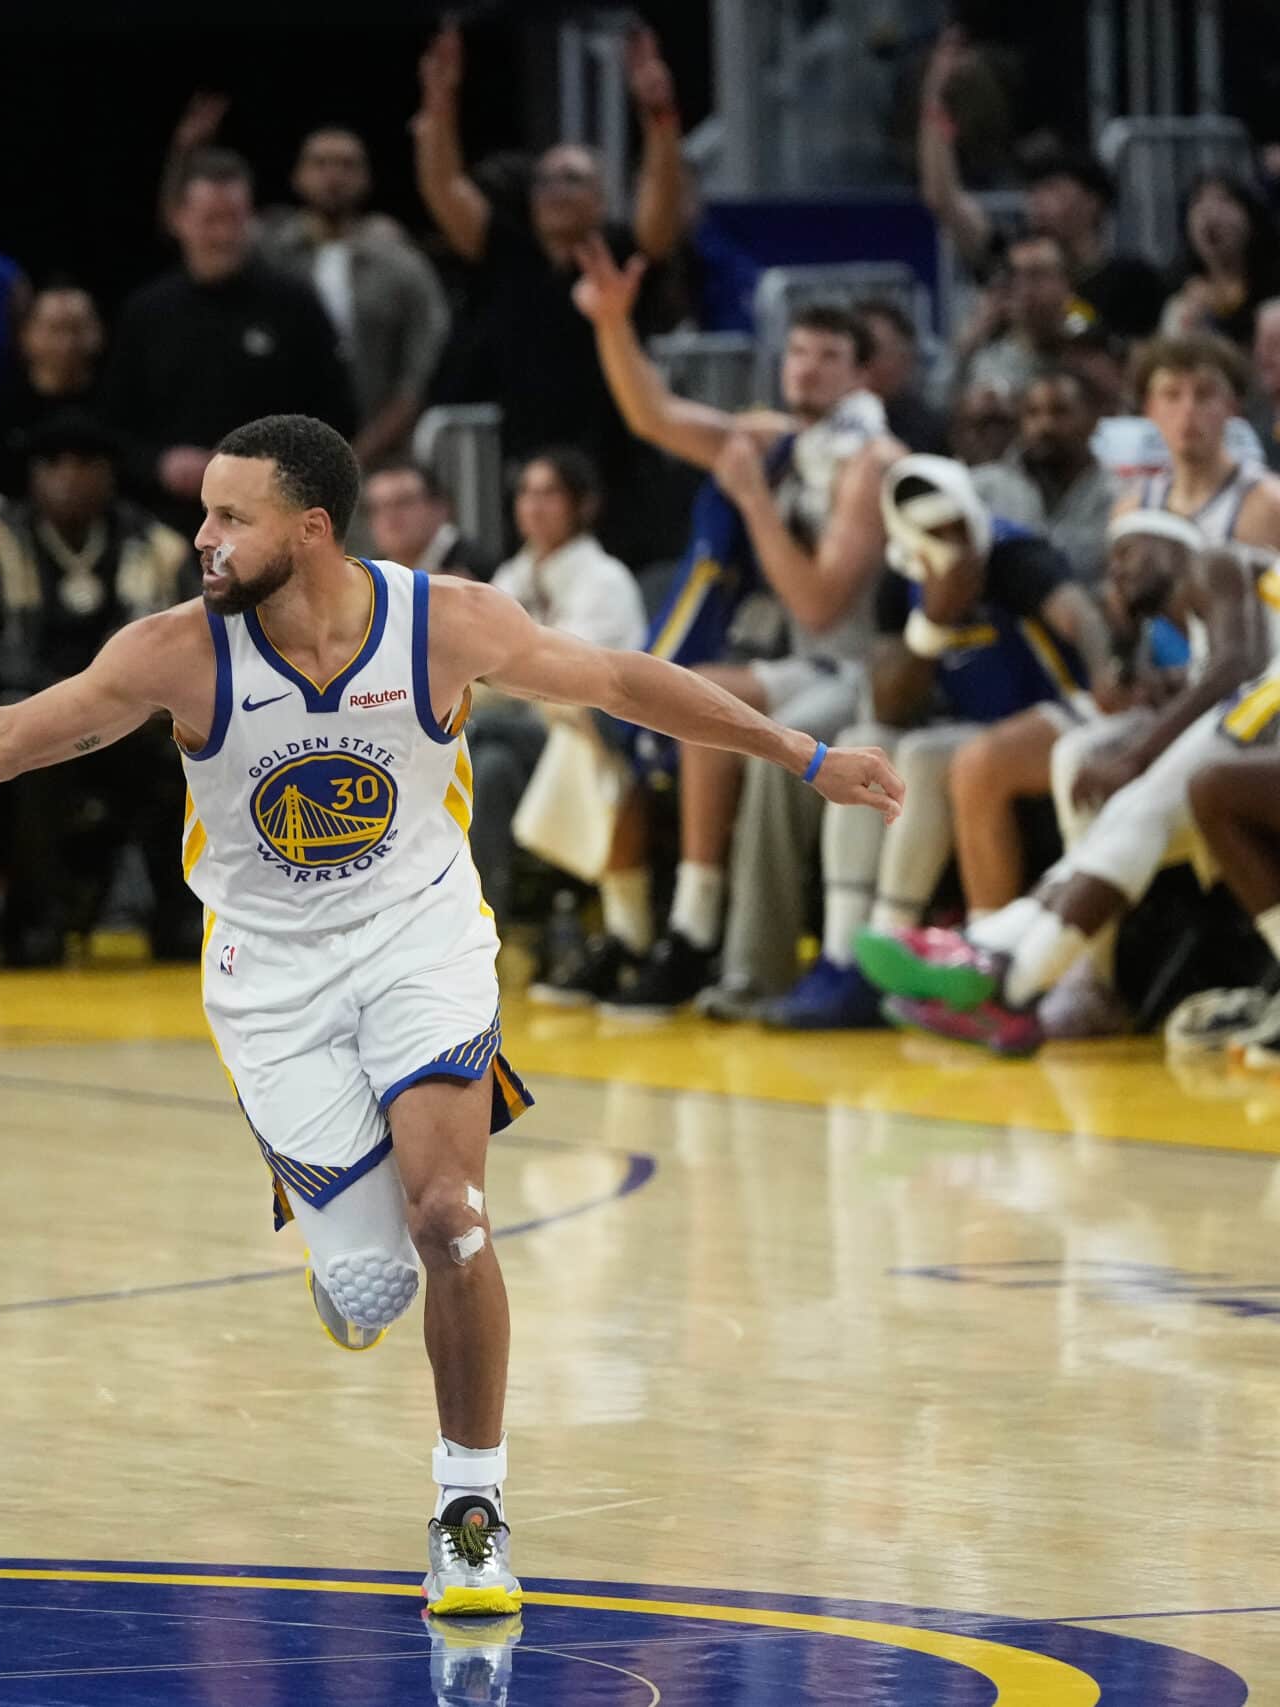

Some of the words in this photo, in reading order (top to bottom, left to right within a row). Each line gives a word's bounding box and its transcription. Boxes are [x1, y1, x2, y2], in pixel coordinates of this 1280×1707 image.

[349, 689, 407, 707] Rakuten
[248, 737, 329, 779] GOLDEN
[339, 736, 395, 767] STATE
[329, 775, 380, 811] 30
[256, 828, 398, 883] WARRIORS
